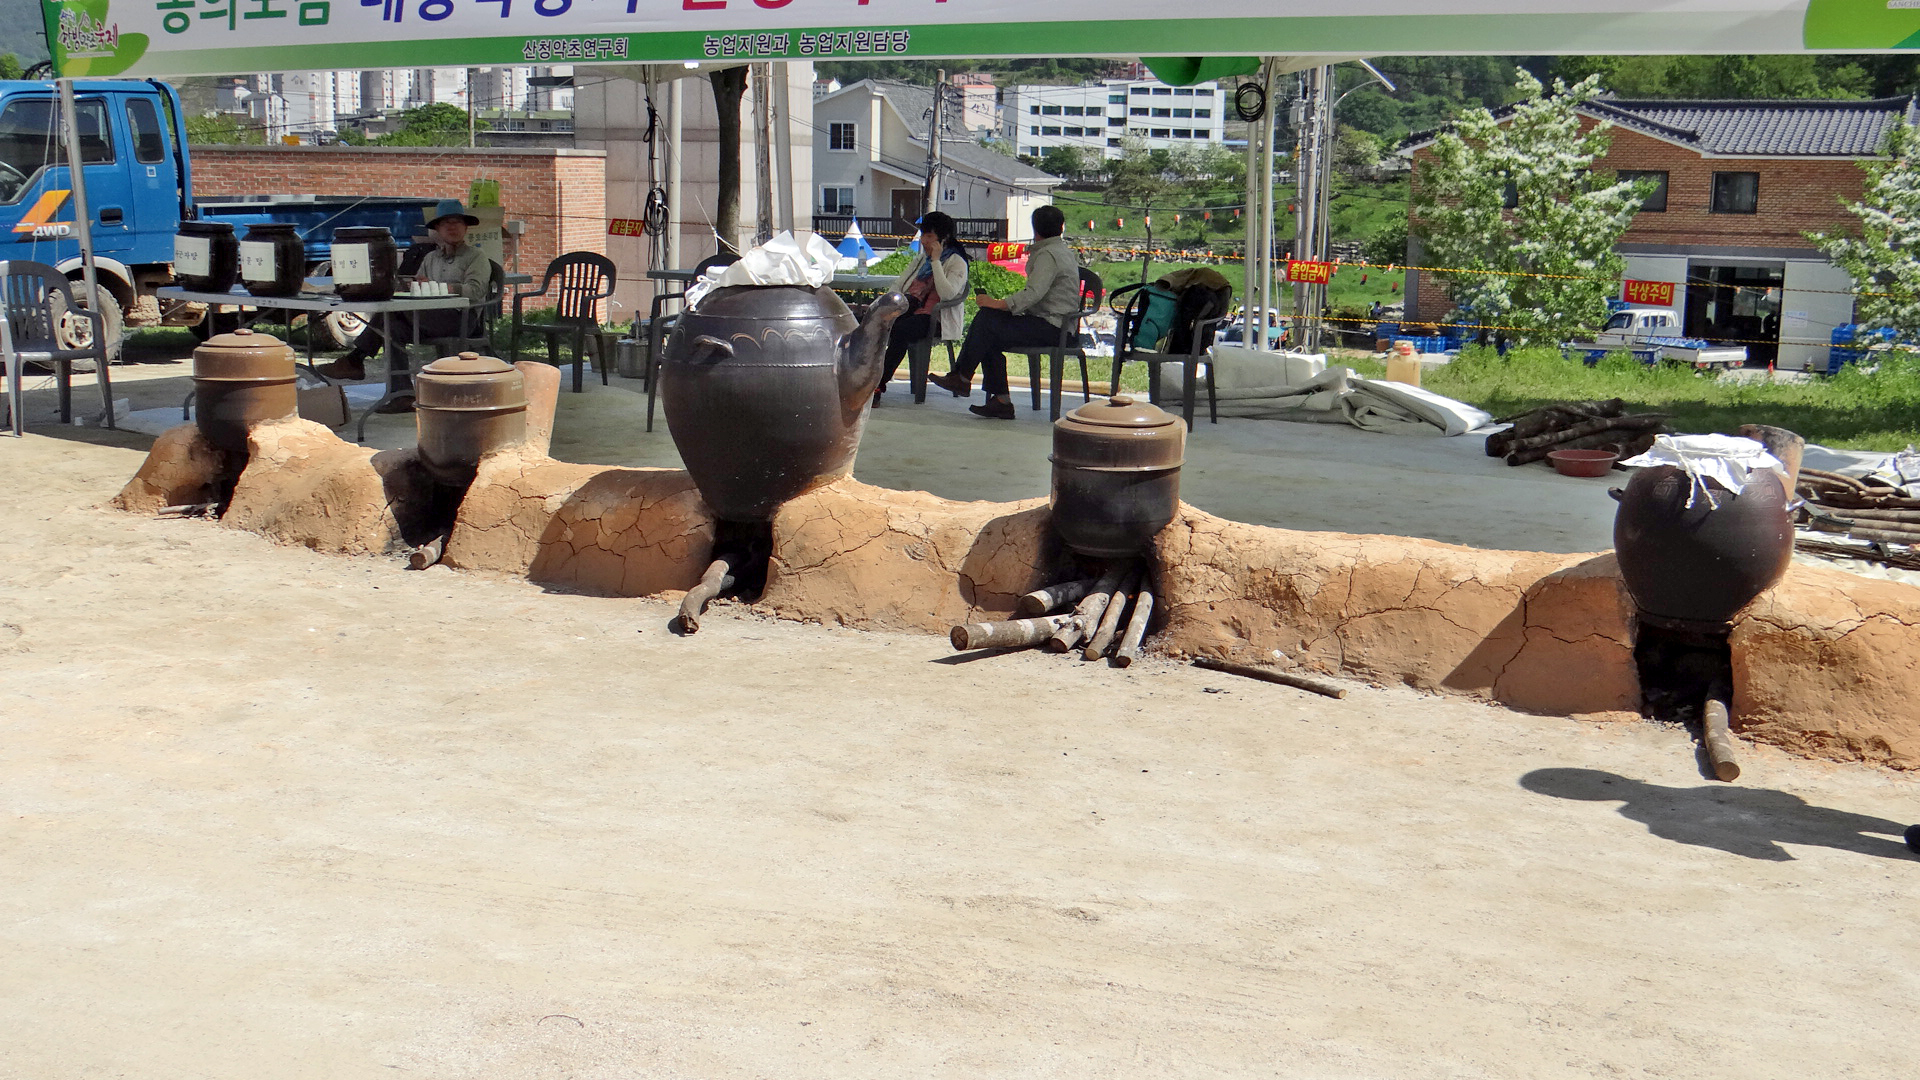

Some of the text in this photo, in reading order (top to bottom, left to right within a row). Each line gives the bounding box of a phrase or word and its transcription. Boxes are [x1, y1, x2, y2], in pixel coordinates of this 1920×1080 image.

[523, 37, 629, 60] 산청약초연구회
[703, 30, 910, 56] 농업지원과 농업지원담당
[32, 224, 71, 237] 4WD
[611, 220, 643, 235] 출입금지
[992, 244, 1019, 260] 위험
[1290, 262, 1328, 282] 출입금지
[1628, 282, 1671, 304] 낙상주의
